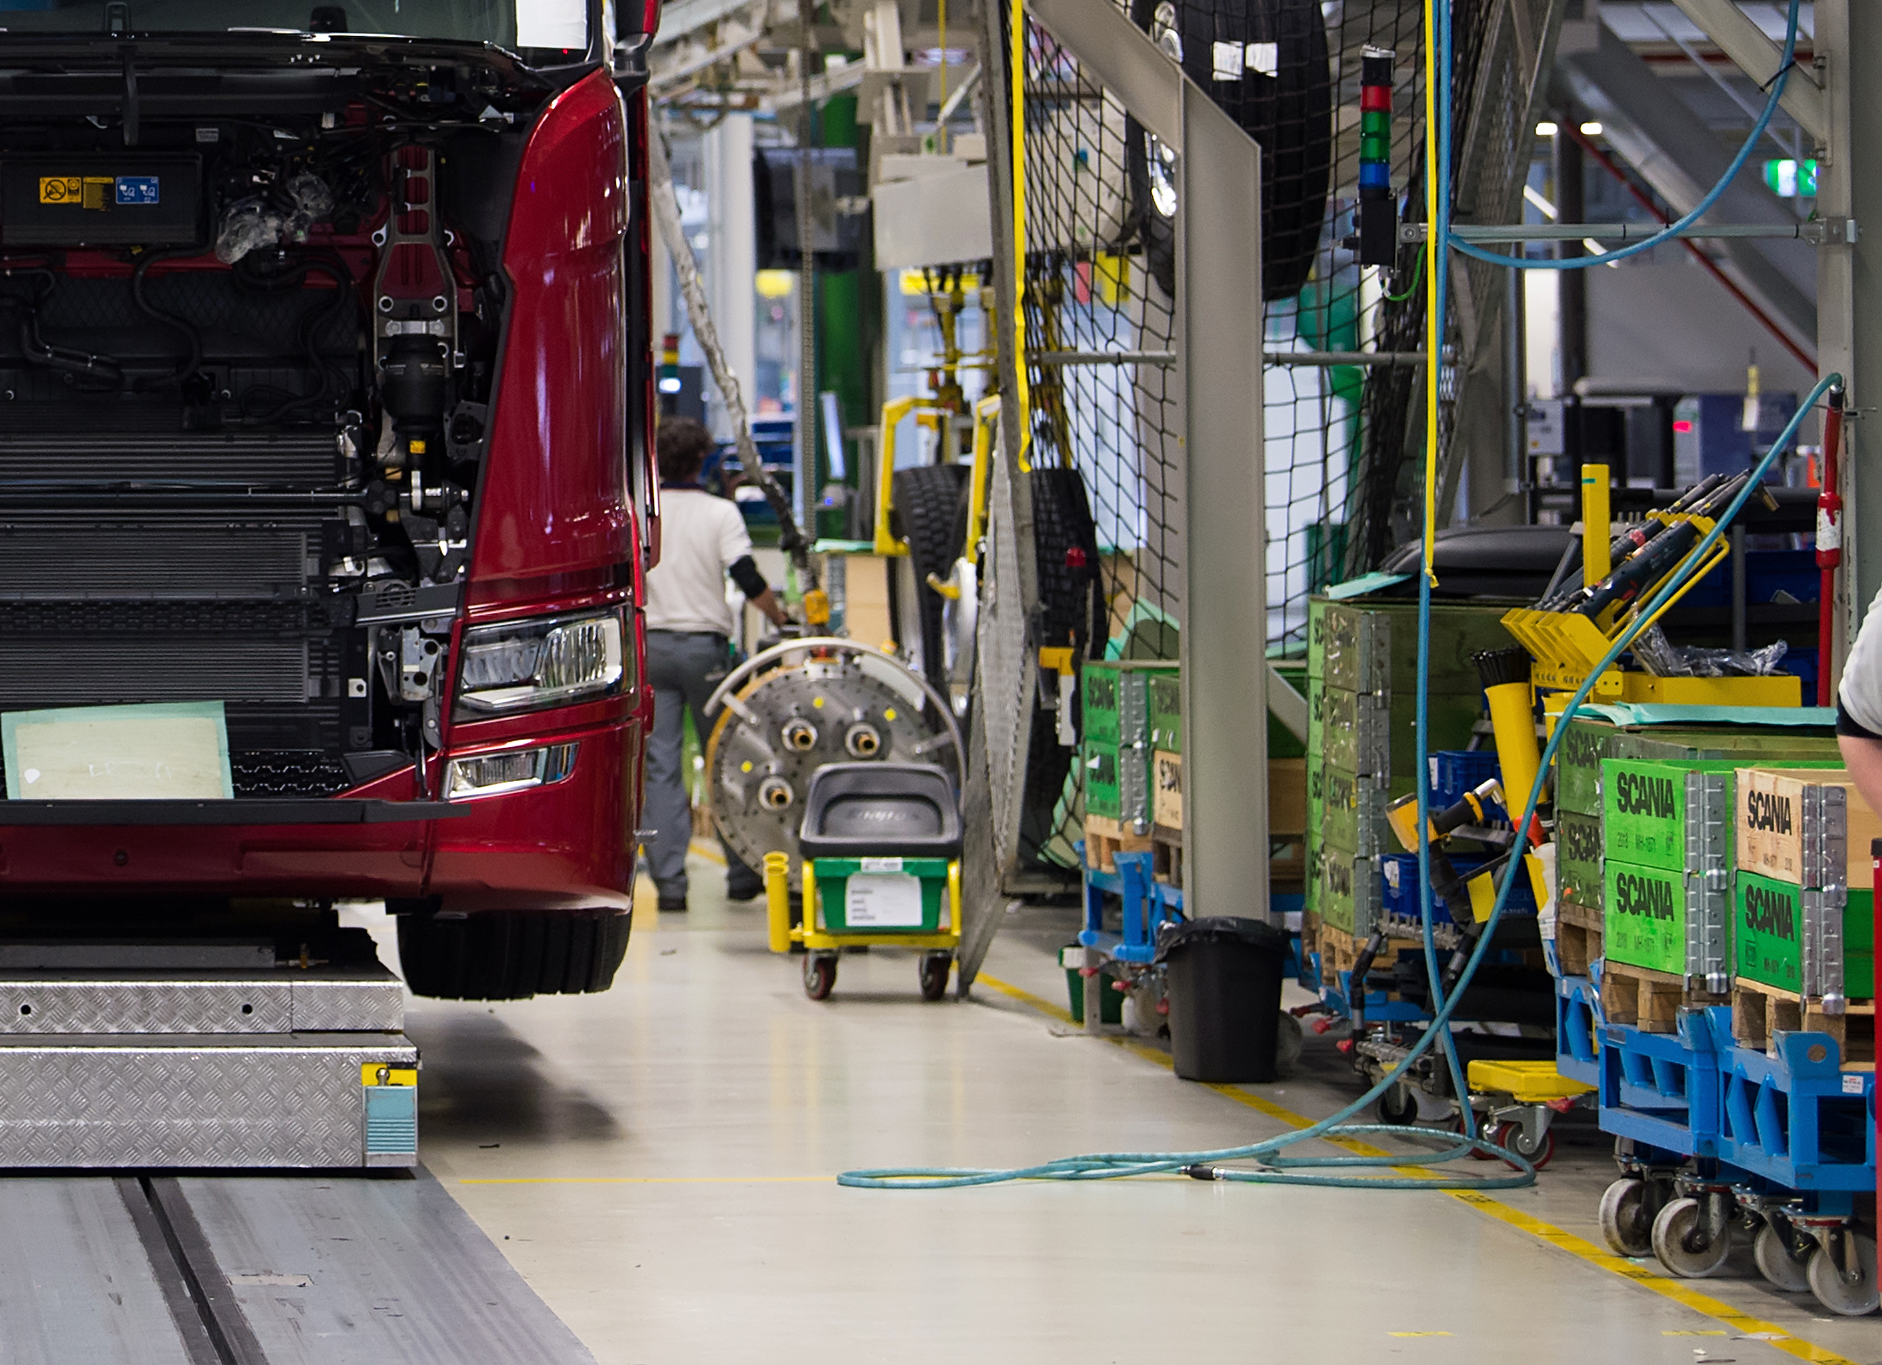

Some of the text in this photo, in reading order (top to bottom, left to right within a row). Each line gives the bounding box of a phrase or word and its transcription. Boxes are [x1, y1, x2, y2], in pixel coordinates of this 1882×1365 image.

[1616, 771, 1676, 821] SCANIA
[1747, 789, 1793, 836] SCANIA
[1616, 872, 1675, 922] SCANIA
[1745, 883, 1795, 942] SCANIA
